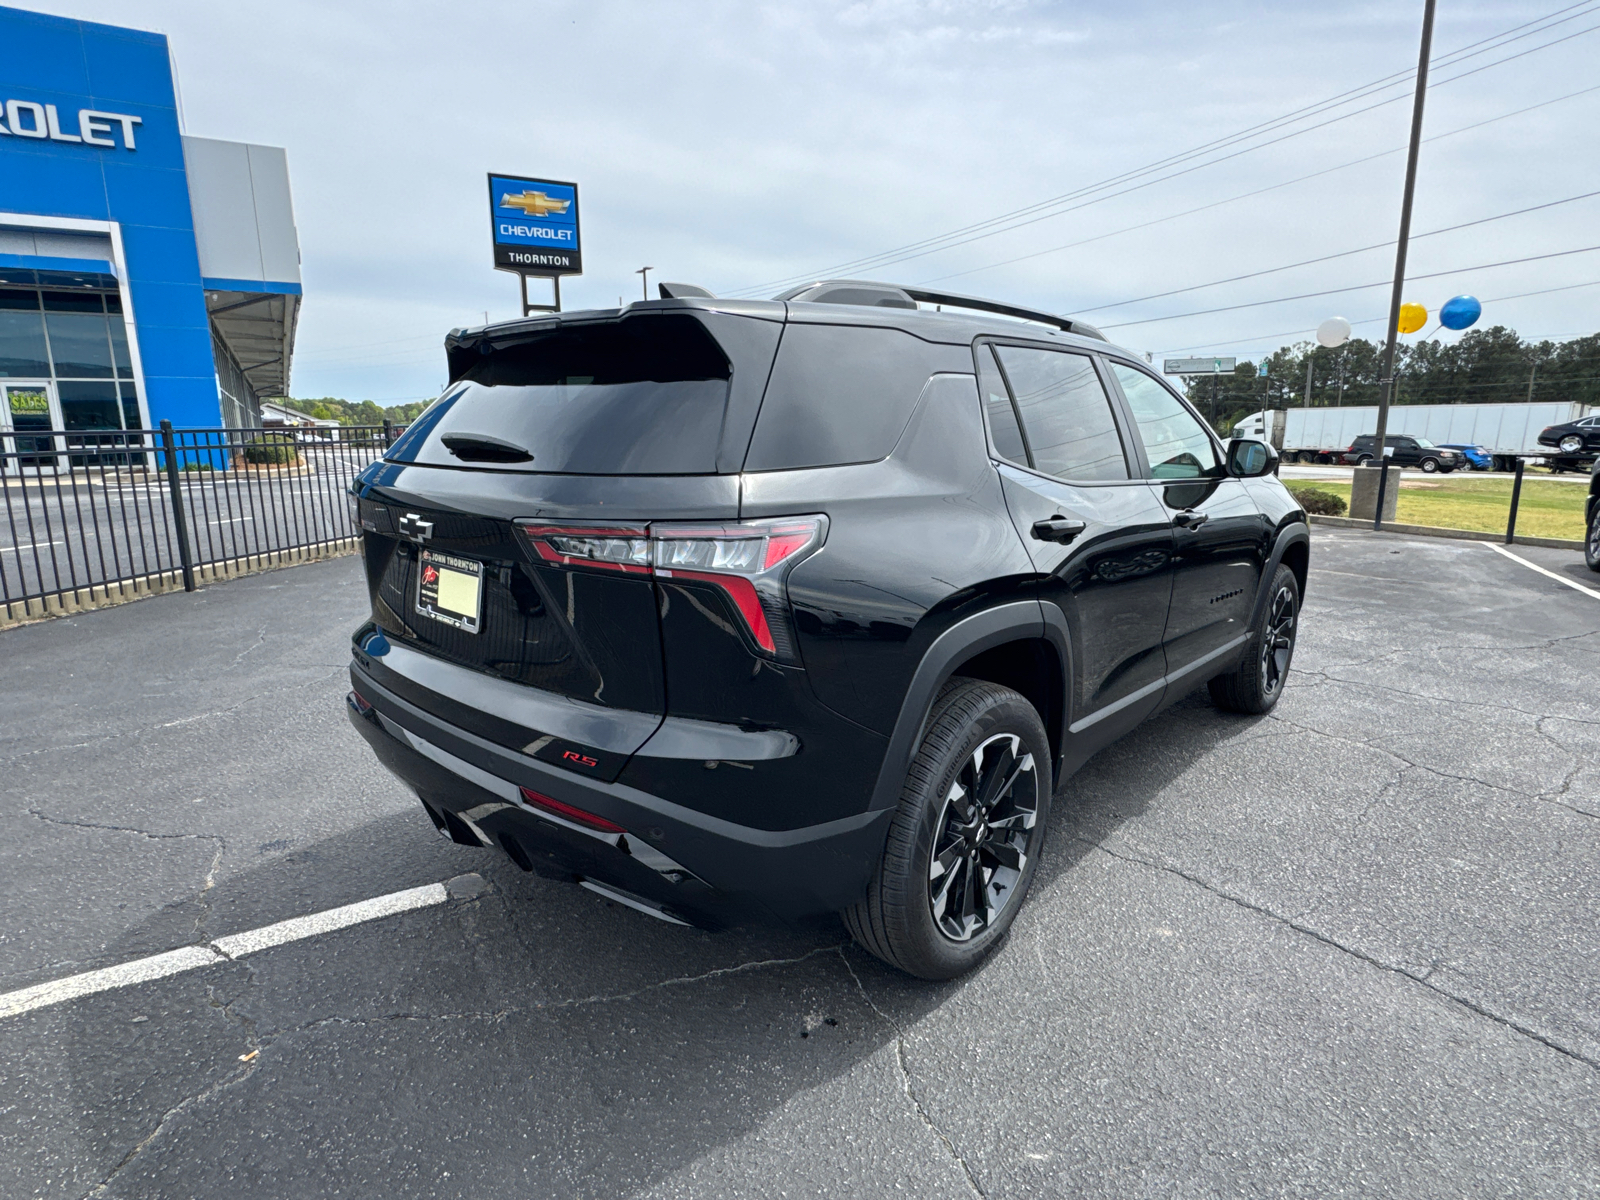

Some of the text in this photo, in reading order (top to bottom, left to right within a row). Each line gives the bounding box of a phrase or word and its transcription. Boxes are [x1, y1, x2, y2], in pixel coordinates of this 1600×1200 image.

[500, 224, 572, 240] CHEVROLET
[508, 252, 570, 266] THORNTON
[563, 750, 599, 767] RS
